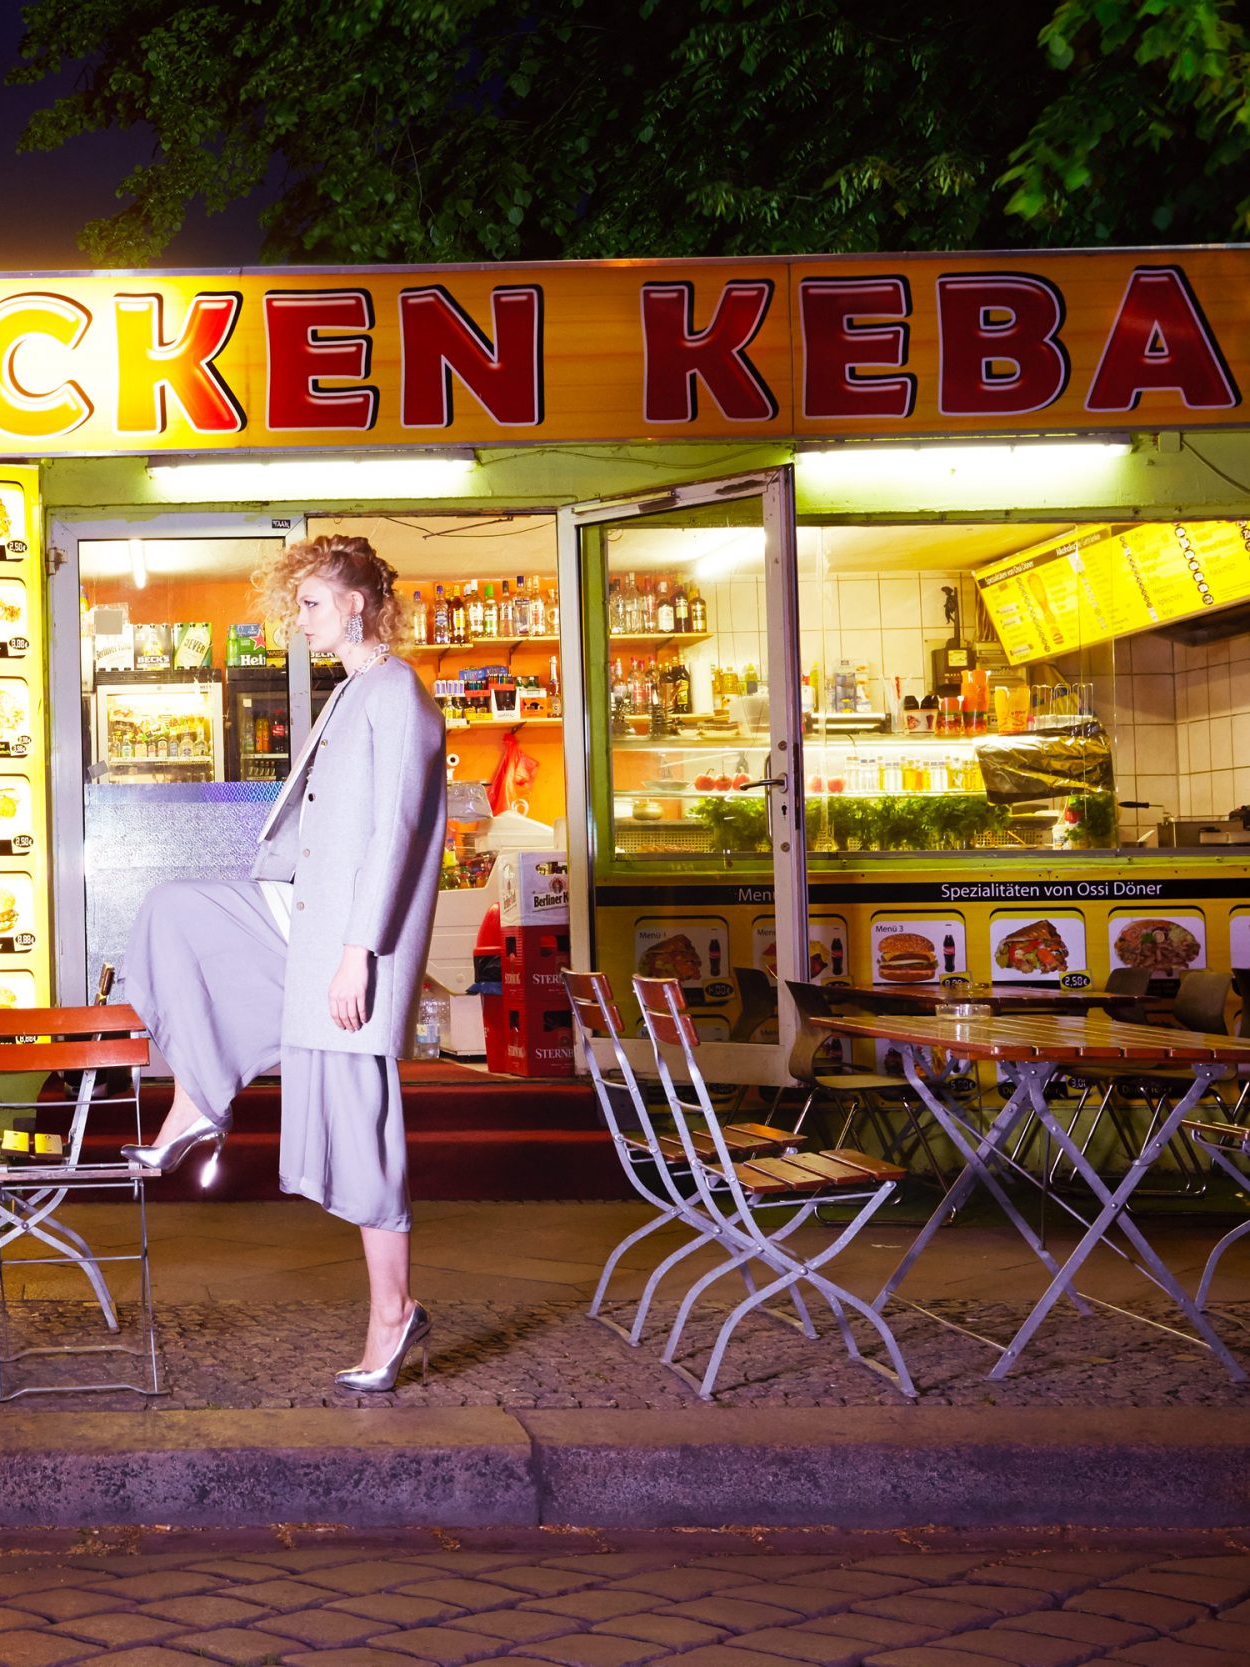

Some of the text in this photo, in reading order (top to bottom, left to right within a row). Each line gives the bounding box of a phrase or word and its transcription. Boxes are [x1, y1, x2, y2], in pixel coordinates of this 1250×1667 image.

[941, 881, 1162, 900] Spezialitäten von Ossi Döner
[533, 894, 562, 908] Berliner
[1064, 976, 1087, 987] 2,50€
[535, 1048, 574, 1059] STERNB
